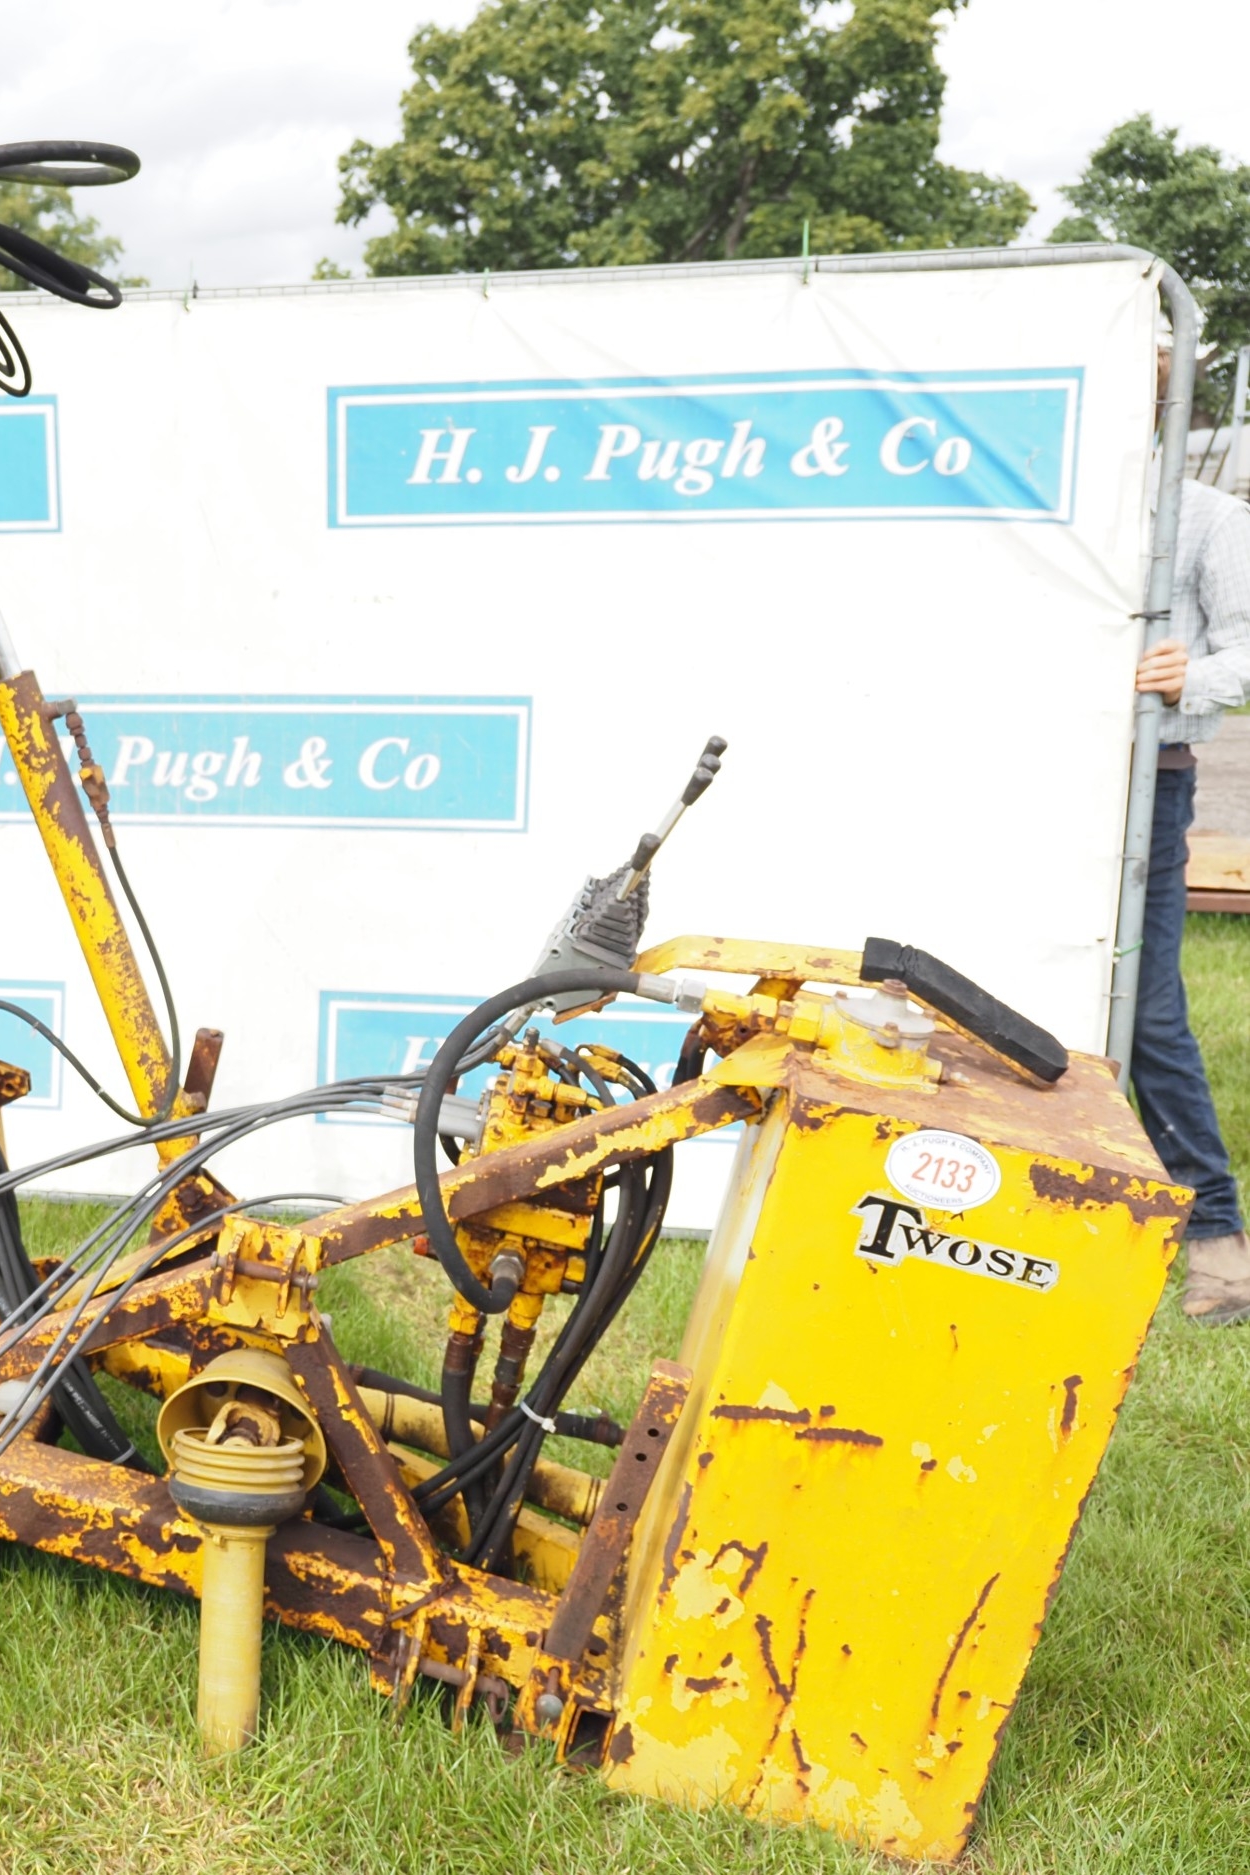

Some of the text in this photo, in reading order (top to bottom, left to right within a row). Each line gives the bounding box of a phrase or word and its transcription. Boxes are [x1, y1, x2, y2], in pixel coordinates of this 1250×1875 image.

[407, 415, 972, 496] H. J. Pugh & Co
[105, 735, 262, 803] Pugh
[282, 735, 333, 790] &
[357, 736, 441, 791] Co
[911, 1151, 977, 1193] 2133
[922, 1137, 948, 1145] PUGH
[959, 1143, 992, 1175] COMPANY
[905, 1183, 963, 1204] AUCTIONEERS
